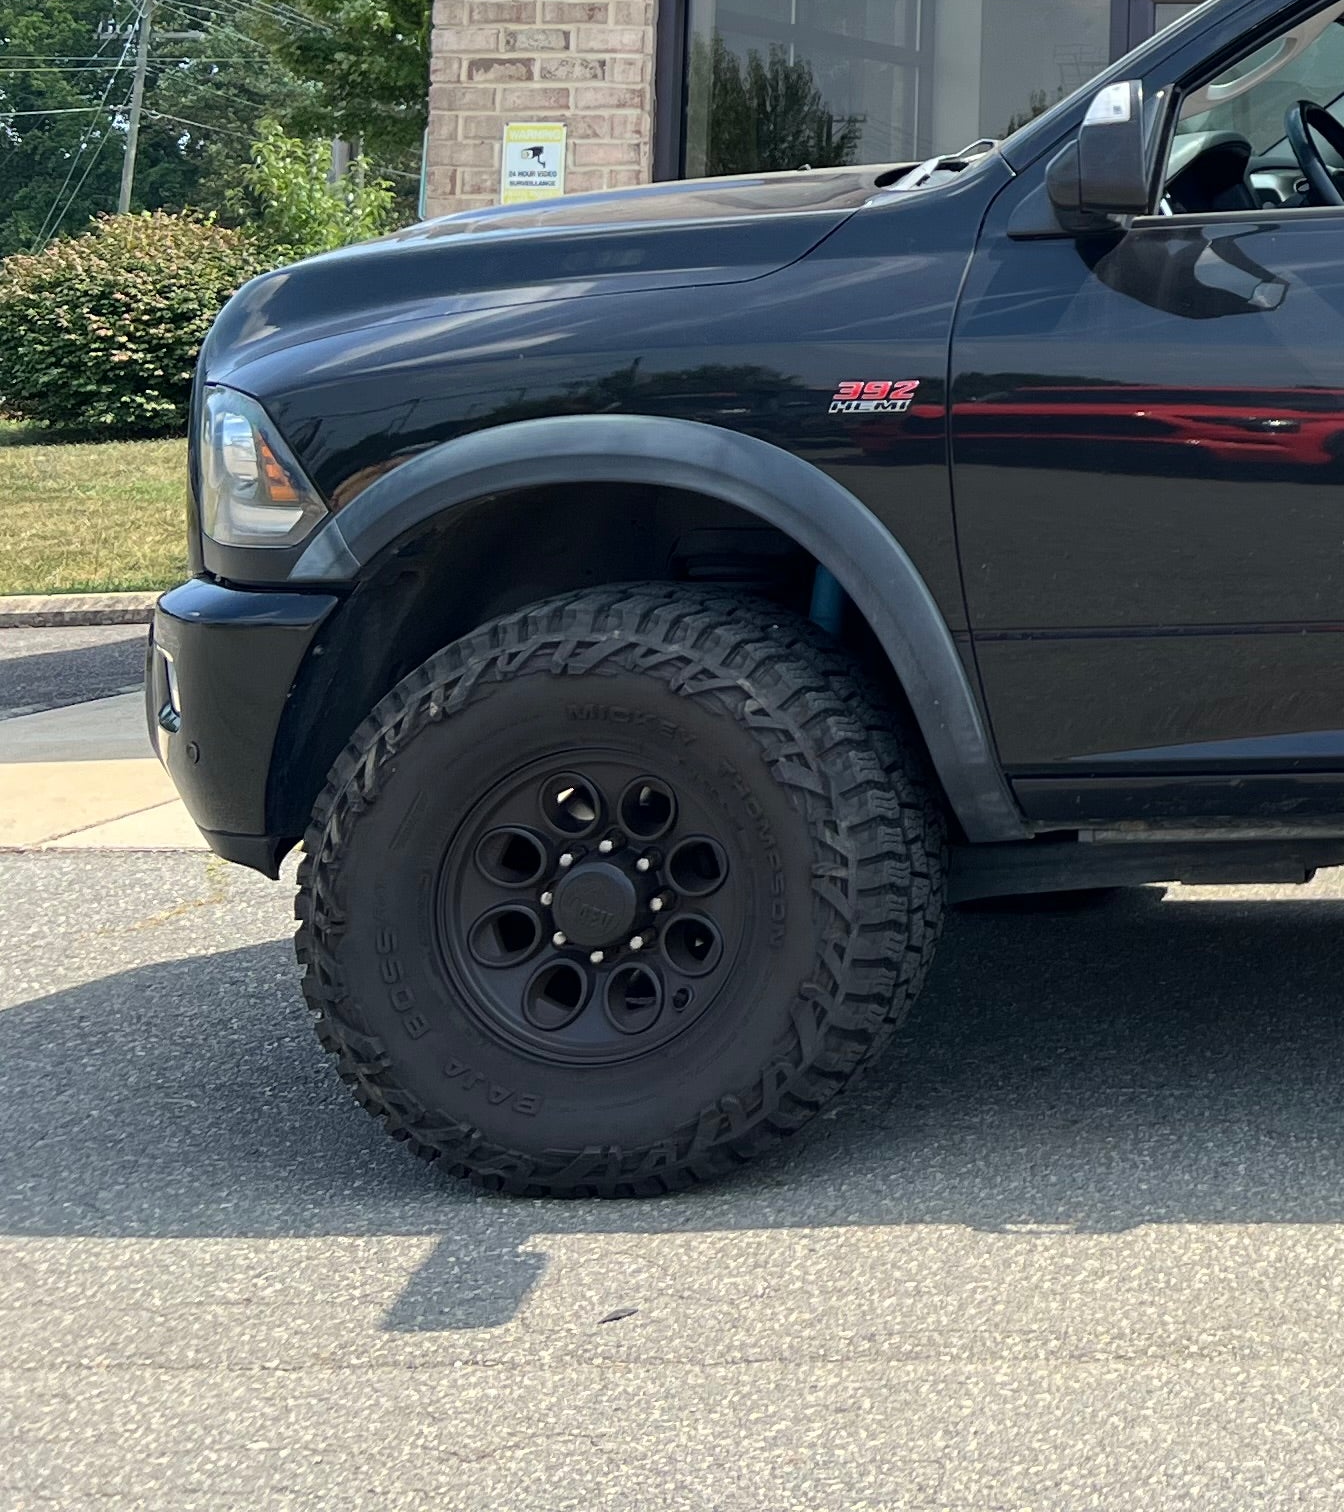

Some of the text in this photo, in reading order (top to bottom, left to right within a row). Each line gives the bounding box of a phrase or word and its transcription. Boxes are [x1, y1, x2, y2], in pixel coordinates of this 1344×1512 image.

[517, 170, 536, 178] HOUR
[537, 170, 558, 178] VIDEO
[833, 380, 920, 399] 392
[828, 399, 912, 414] HEMI
[565, 702, 786, 948] MICKEY THOMPSON
[376, 926, 545, 1117] BAJA BOSS
